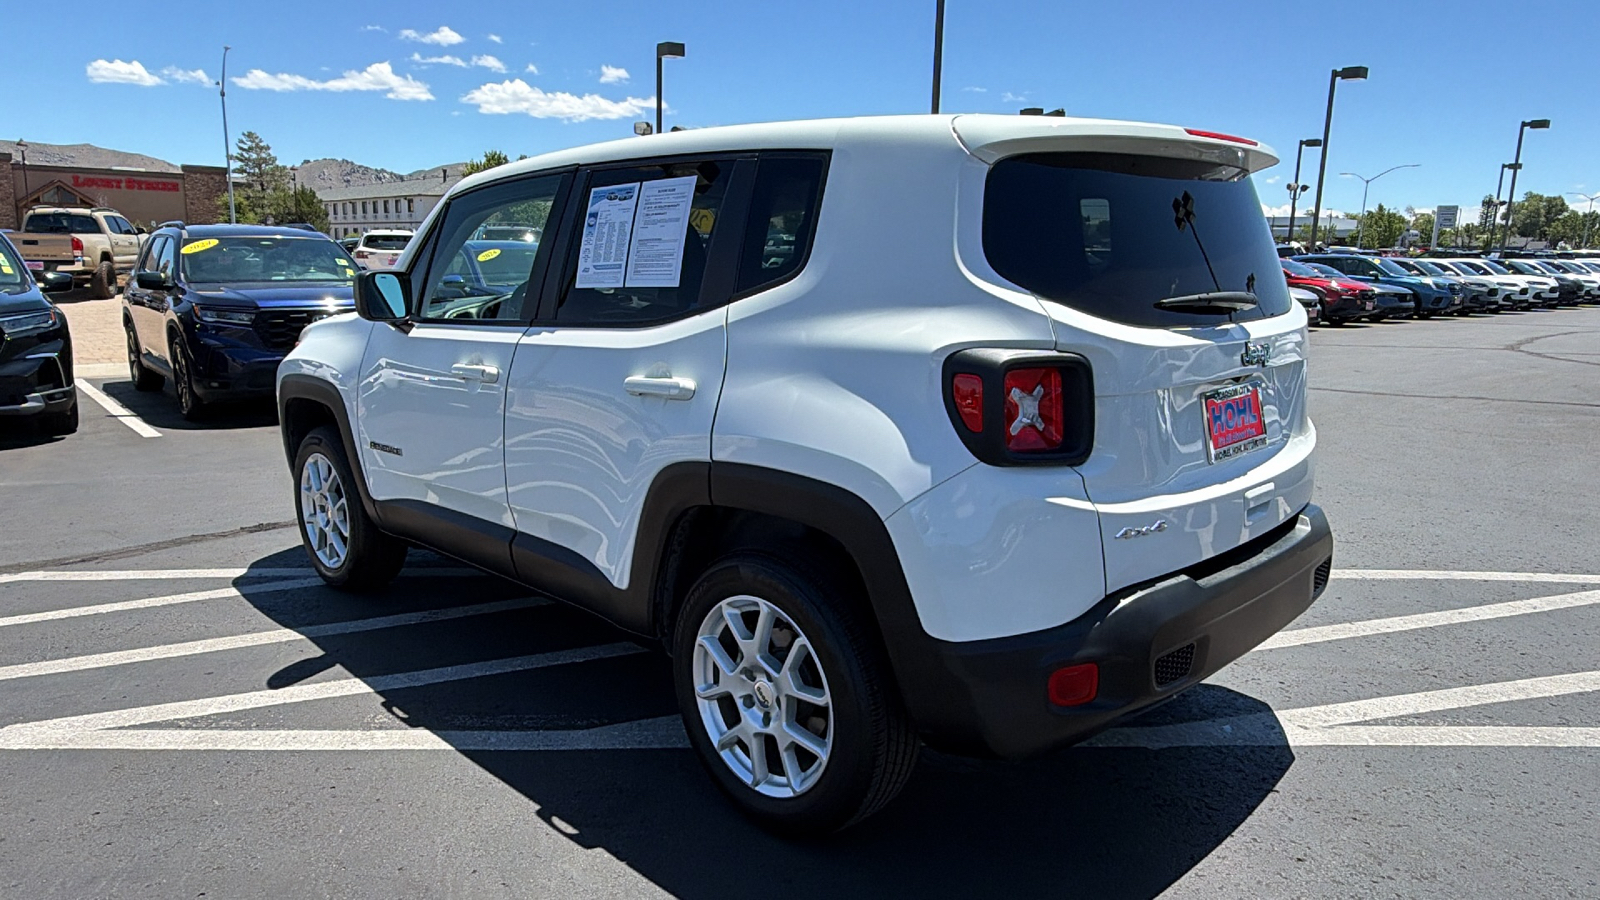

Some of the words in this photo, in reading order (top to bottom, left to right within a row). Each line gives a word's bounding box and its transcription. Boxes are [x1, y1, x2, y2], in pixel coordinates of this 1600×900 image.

[73, 175, 122, 189] LUCKY
[1240, 341, 1270, 367] Jeep
[1211, 397, 1257, 434] HOHL
[756, 686, 769, 704] Jeep
